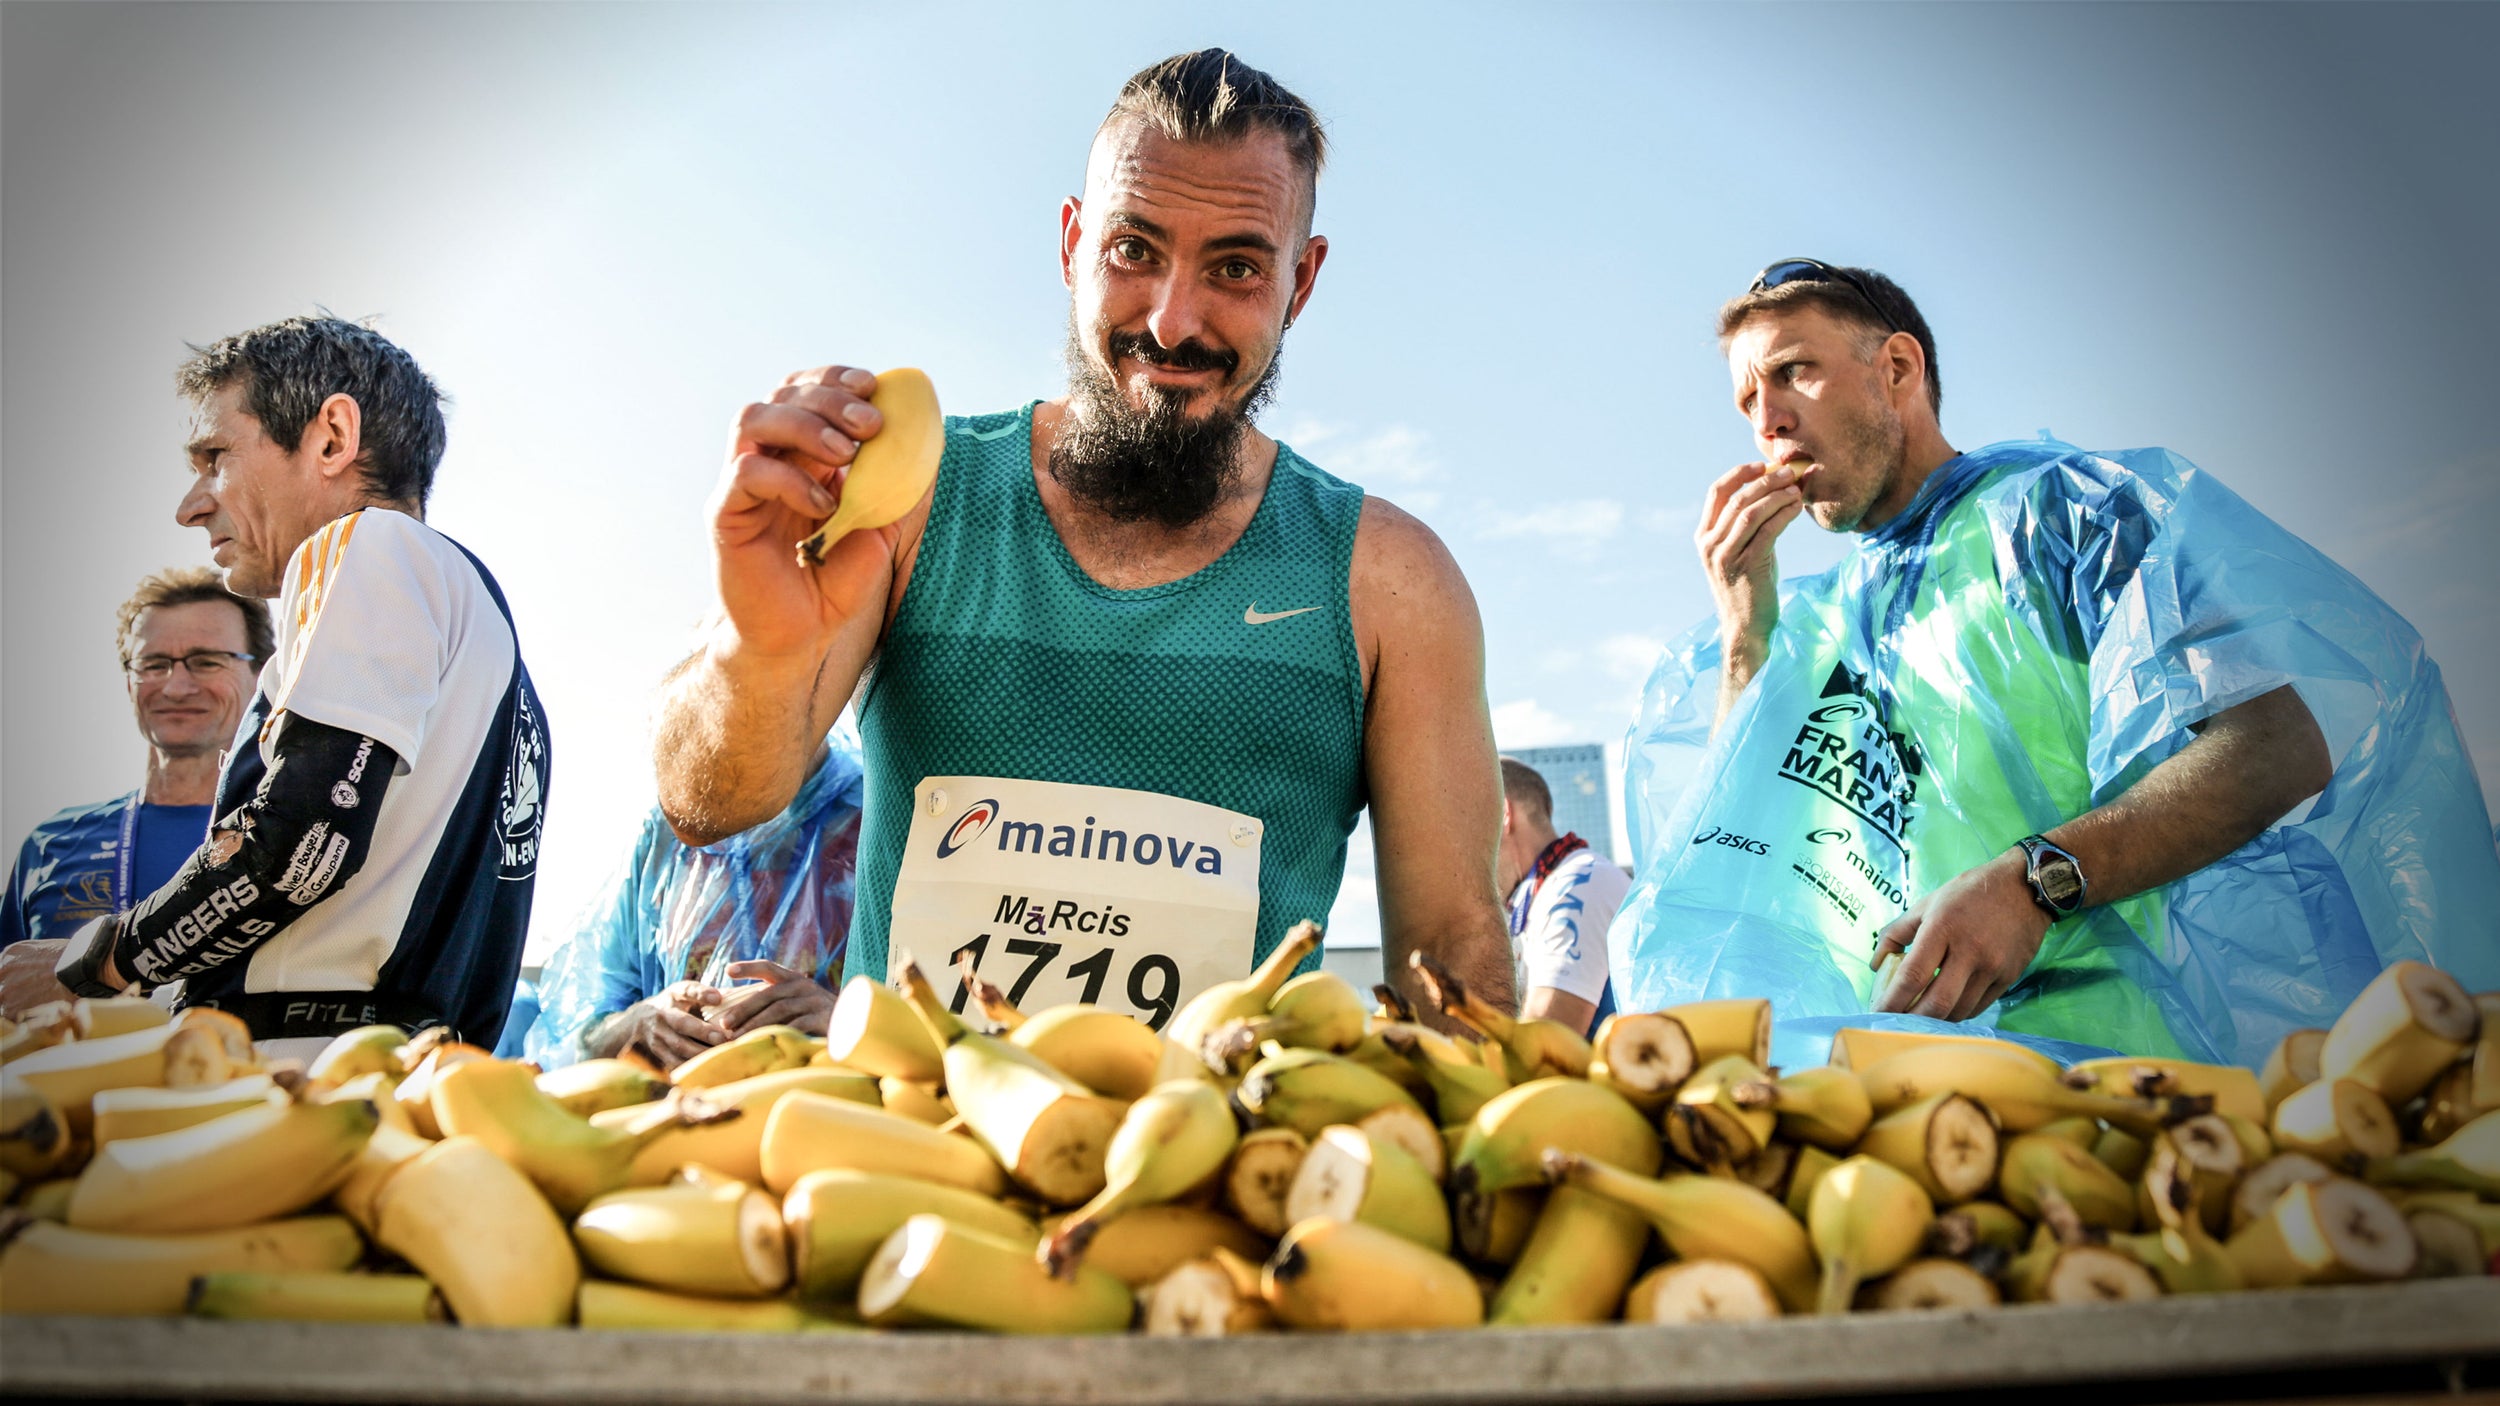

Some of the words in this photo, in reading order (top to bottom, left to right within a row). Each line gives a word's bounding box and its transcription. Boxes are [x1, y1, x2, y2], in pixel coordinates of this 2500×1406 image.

[310, 838, 346, 892] Groupama
[997, 816, 1223, 876] mainova
[1716, 832, 1771, 856] asics
[1795, 852, 1866, 915] SPORTSTADT
[132, 874, 260, 978] ANGERS
[167, 918, 277, 981] RAILS
[948, 933, 1181, 1034] 1719
